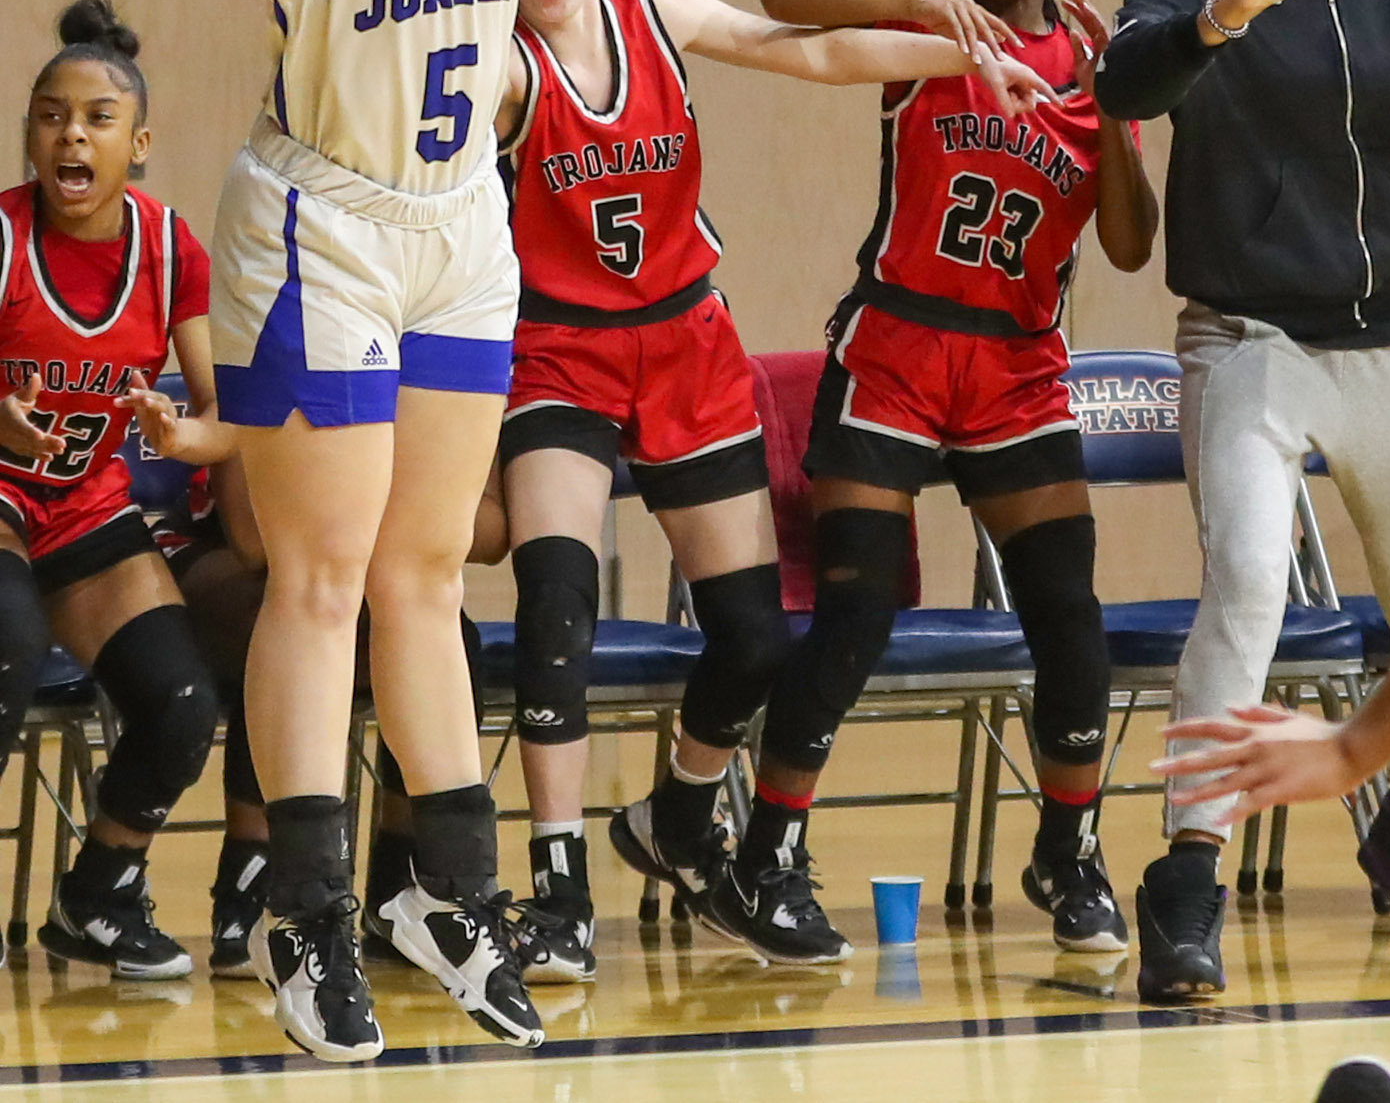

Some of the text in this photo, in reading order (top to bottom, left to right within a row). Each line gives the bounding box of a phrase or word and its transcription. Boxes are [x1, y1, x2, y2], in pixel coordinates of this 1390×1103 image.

[415, 43, 479, 164] 5
[541, 132, 686, 194] TROJANS
[933, 112, 1087, 198] TROJANS
[590, 193, 645, 279] 5
[935, 170, 1045, 281] 23
[1074, 405, 1180, 434] TATE
